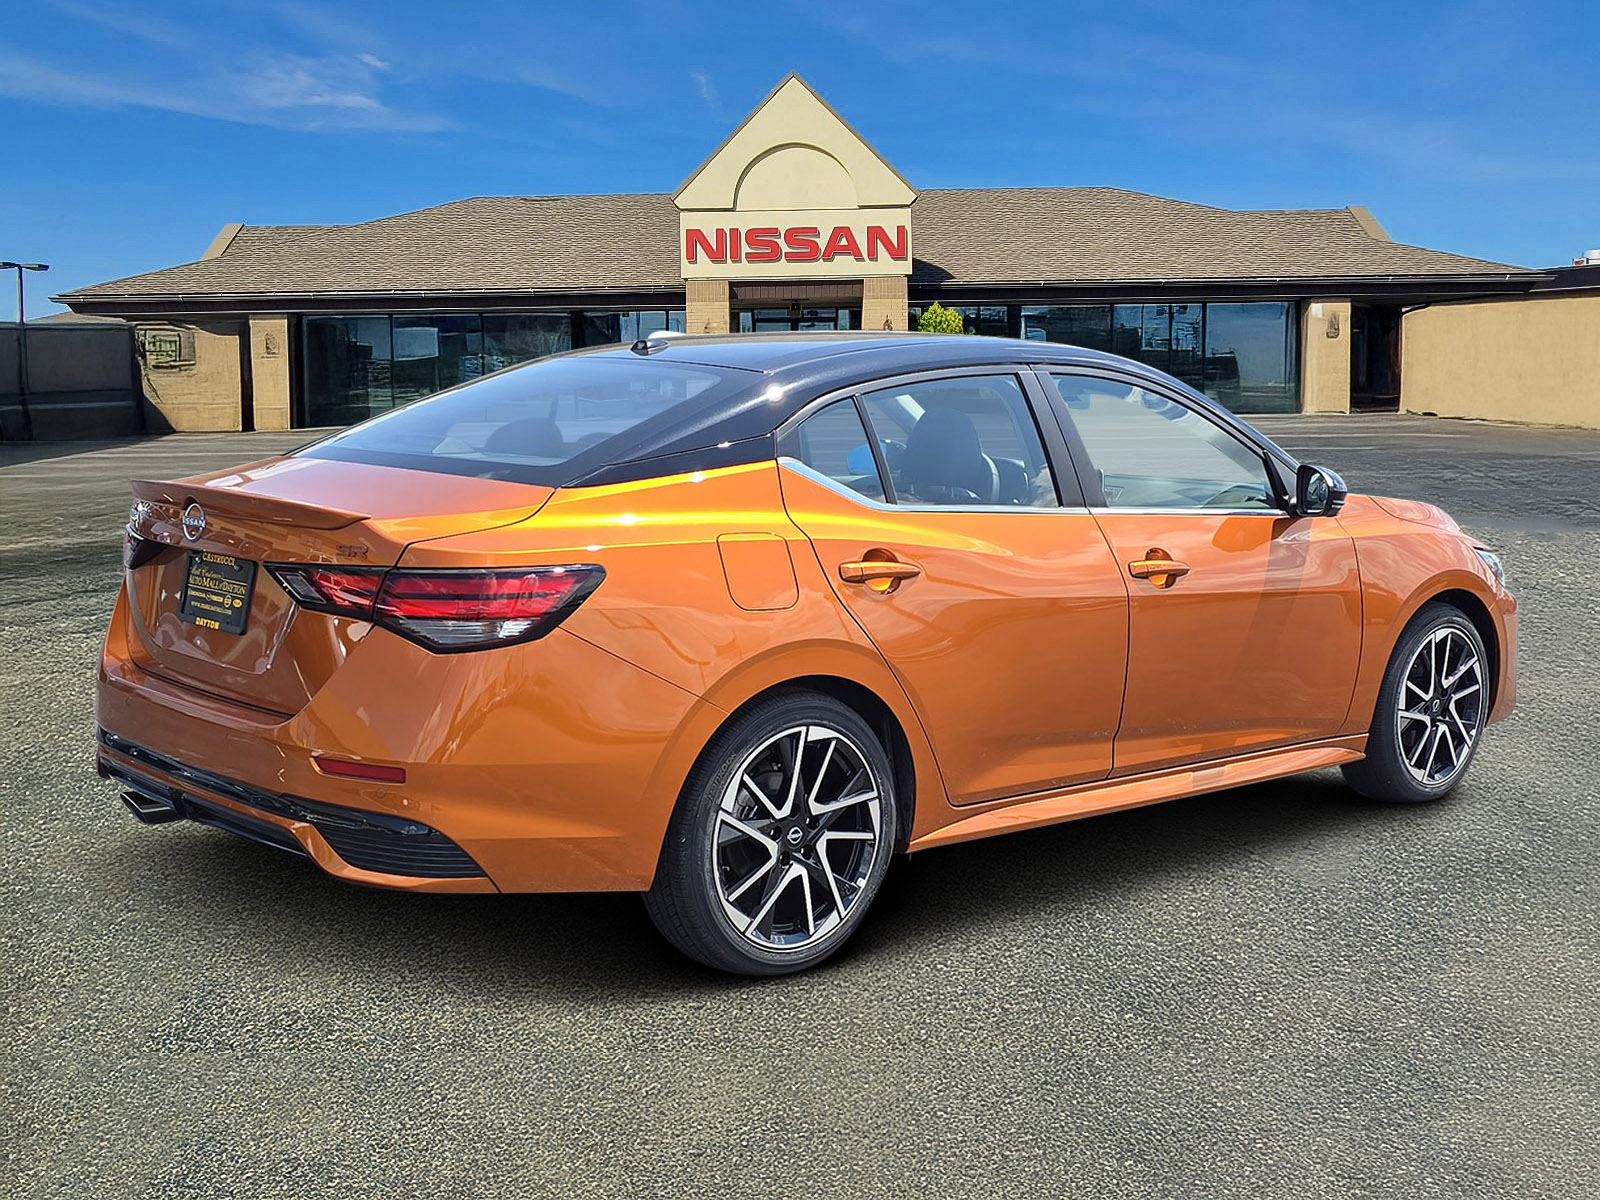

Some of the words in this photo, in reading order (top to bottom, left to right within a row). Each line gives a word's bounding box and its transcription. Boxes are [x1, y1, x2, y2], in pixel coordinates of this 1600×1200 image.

[685, 225, 908, 264] NISSAN
[203, 577, 220, 590] MALL
[195, 617, 220, 630] DAYTON
